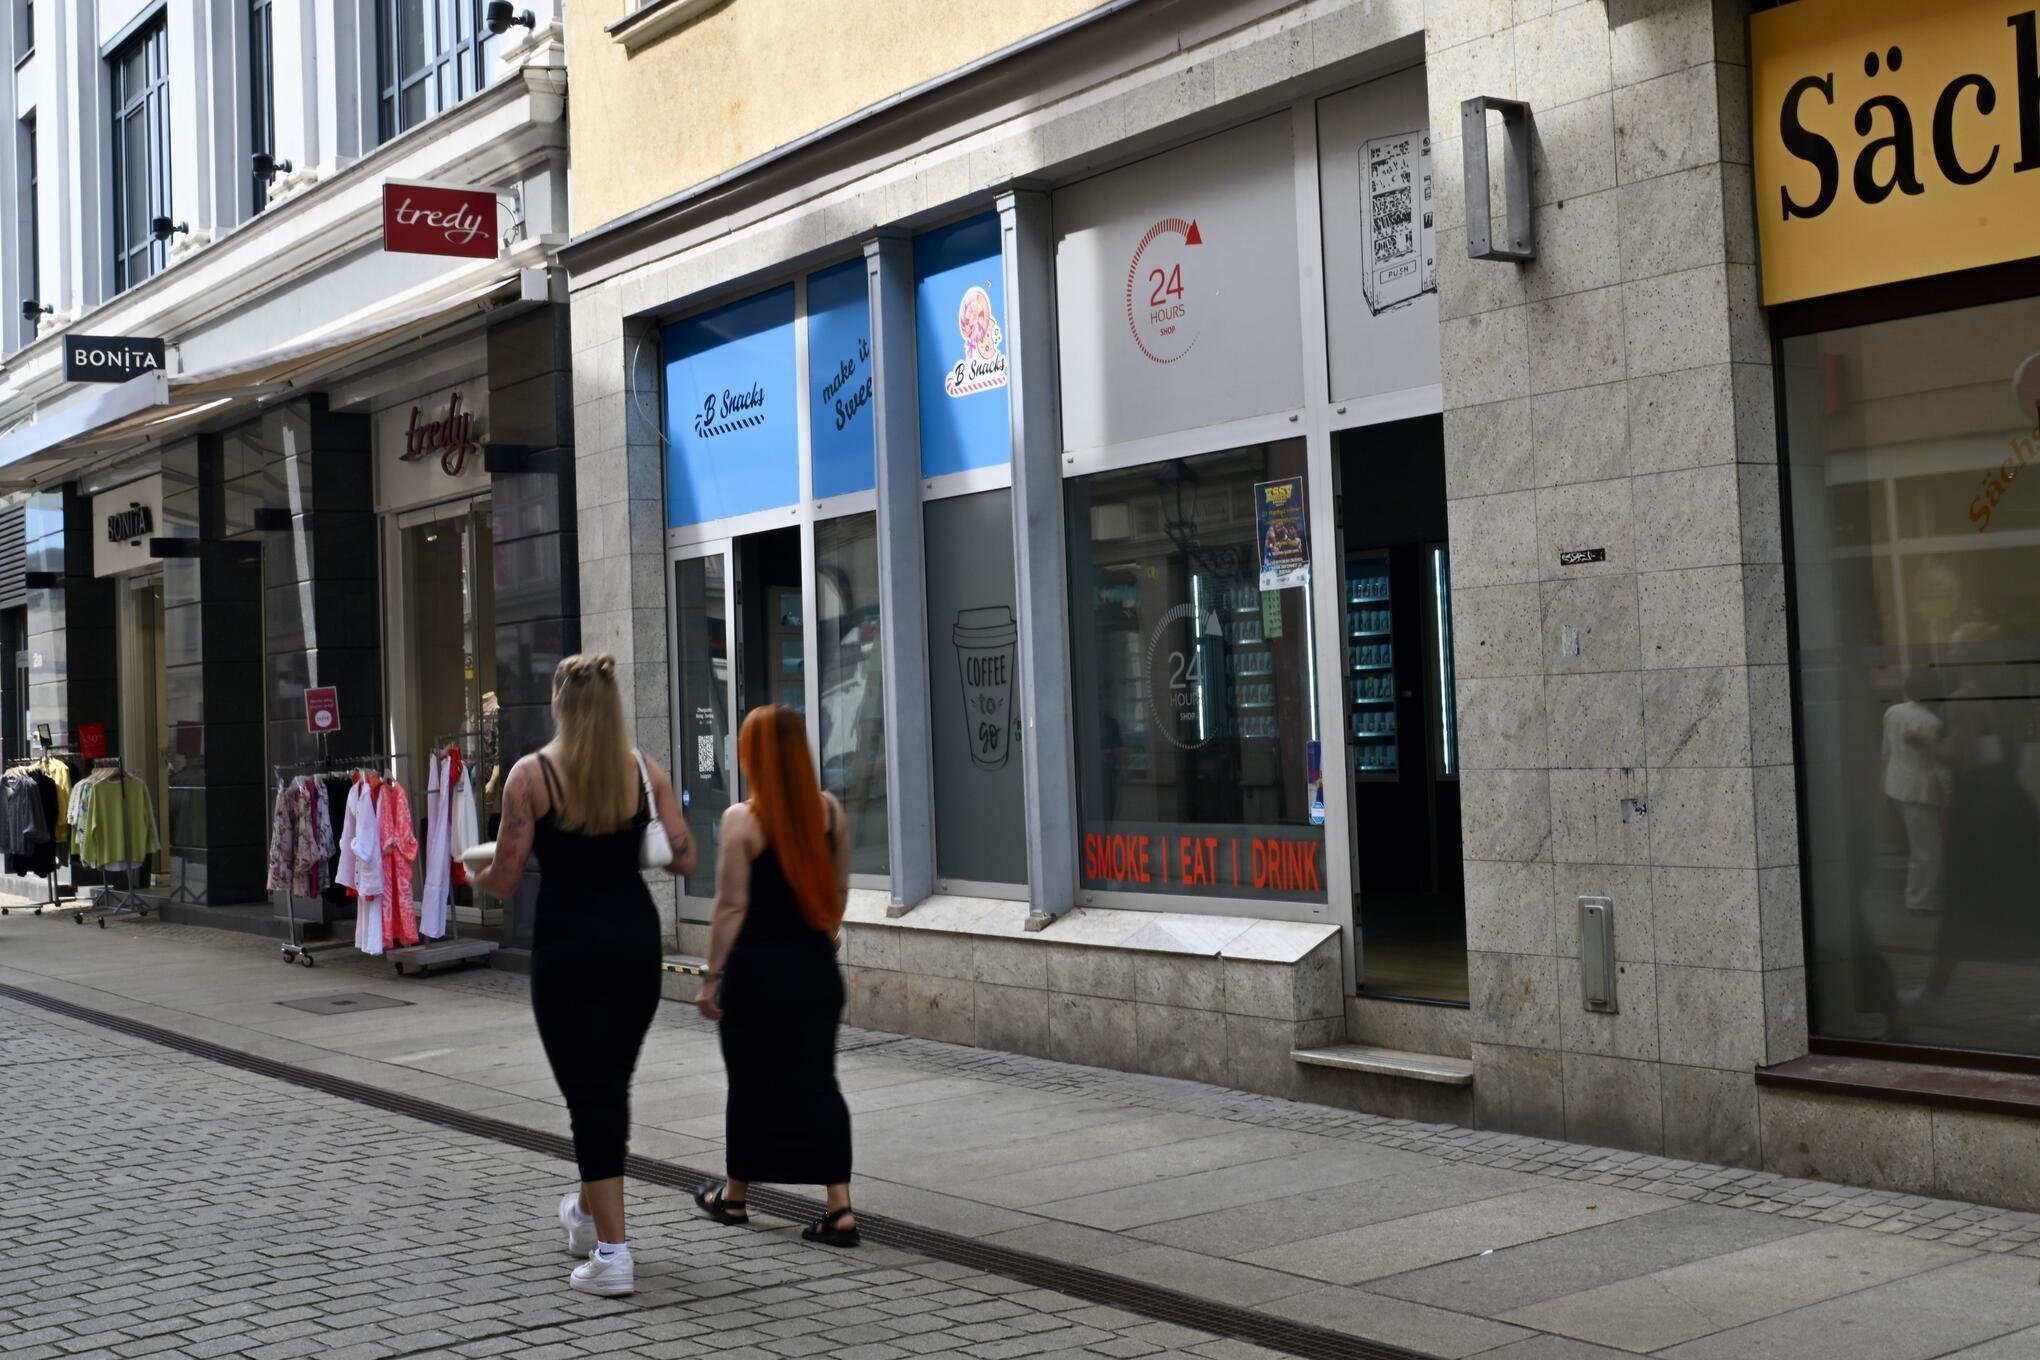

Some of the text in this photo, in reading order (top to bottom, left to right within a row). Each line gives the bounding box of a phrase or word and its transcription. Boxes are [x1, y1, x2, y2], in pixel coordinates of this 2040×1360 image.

[395, 197, 490, 245] tredy
[1148, 263, 1185, 306] 24
[1150, 304, 1185, 325] HOURS
[1160, 325, 1176, 337] SHOP
[822, 338, 870, 405] make it
[955, 353, 1005, 387] B Snacks
[703, 381, 765, 427] B Snacks
[405, 392, 479, 476] tredy
[966, 655, 1006, 687] COFFEE
[1168, 650, 1204, 689] 24
[978, 692, 997, 716] to
[1179, 712, 1196, 721] SHOP
[978, 720, 1001, 754] go
[1084, 832, 1151, 883] SMOKE
[1180, 836, 1218, 886] EAT
[1251, 839, 1320, 892] DRINK
